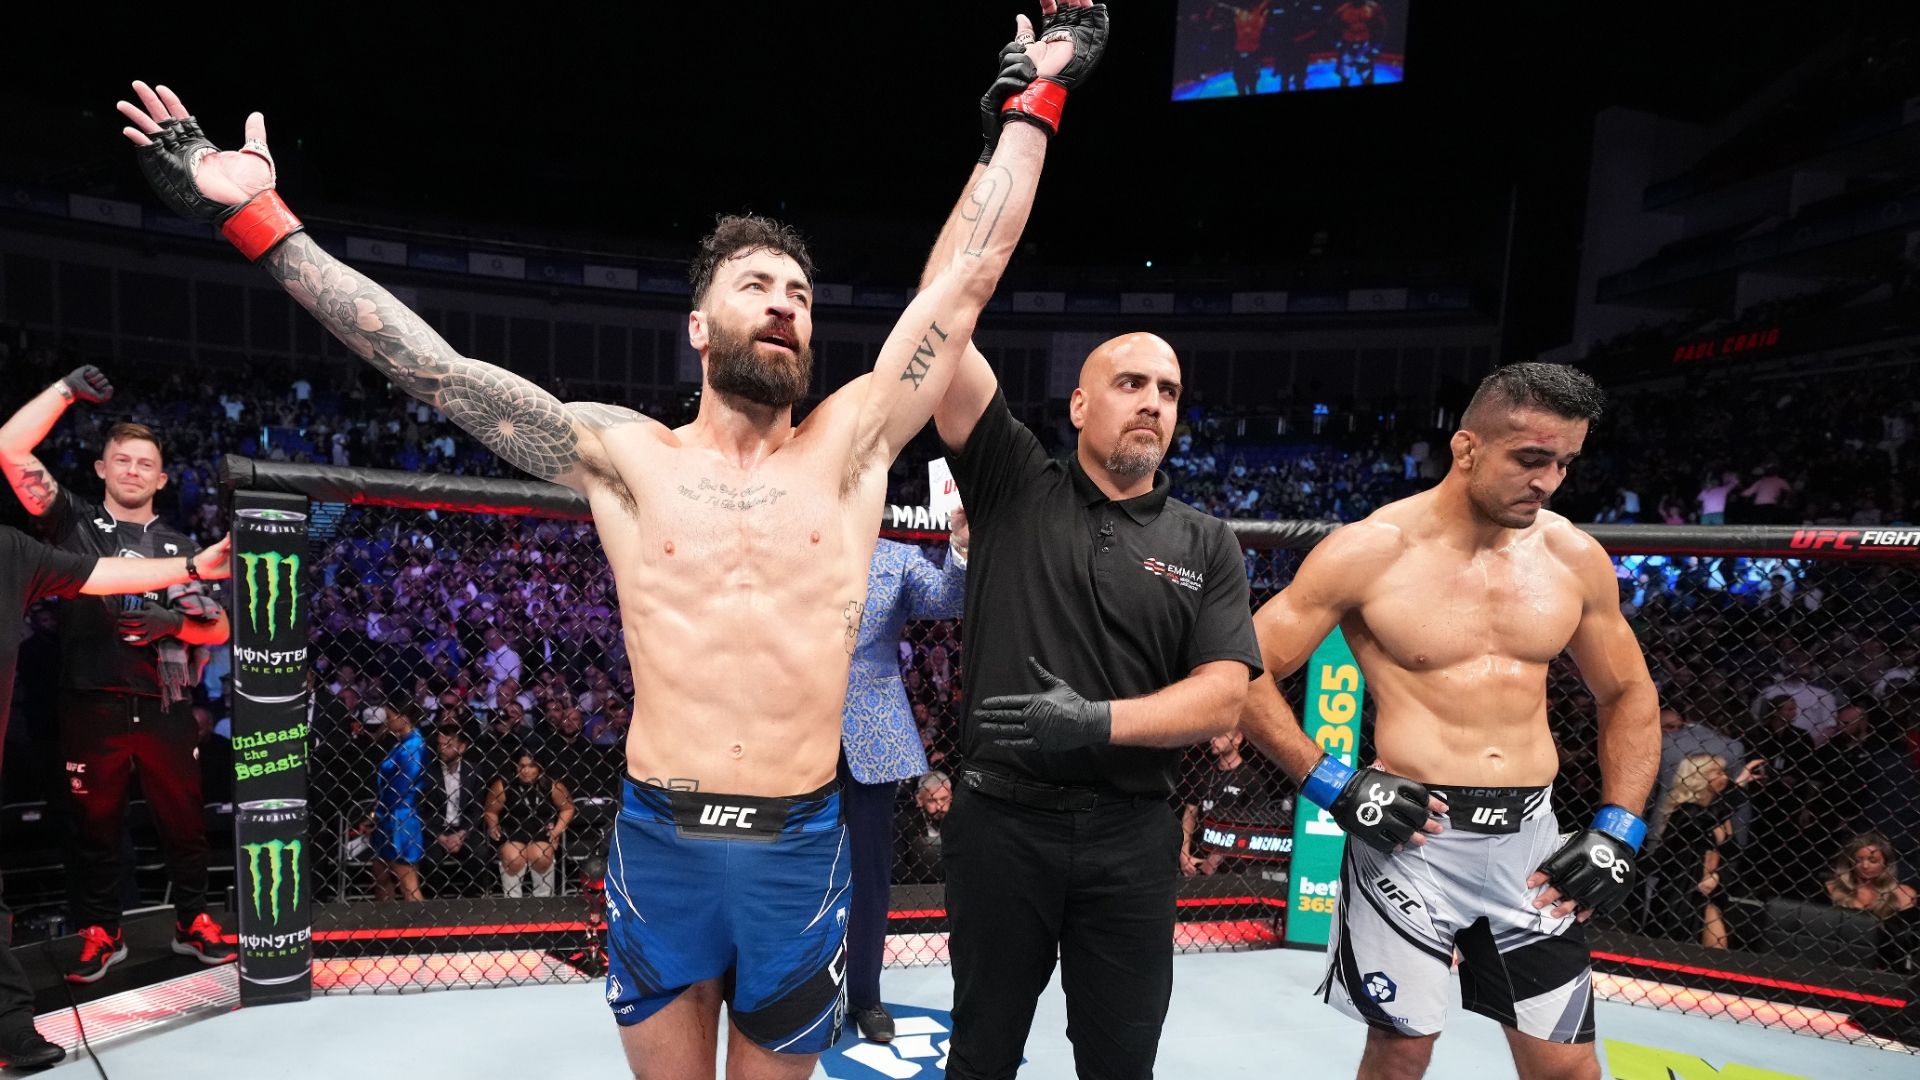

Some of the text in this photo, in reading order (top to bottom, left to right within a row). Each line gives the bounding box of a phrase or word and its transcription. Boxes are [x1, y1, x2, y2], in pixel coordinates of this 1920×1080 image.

[1673, 328, 1780, 363] PAUL CRAIG
[1790, 530, 1860, 550] UFC
[242, 664, 302, 674] ENERGY
[232, 723, 309, 751] Unleash
[244, 749, 268, 761] the
[700, 804, 757, 829] UFC
[1203, 828, 1293, 852] CRAIG MUNIZ
[1299, 877, 1337, 896] bet
[1376, 877, 1421, 915] UFC
[247, 944, 305, 958] ENERGY
